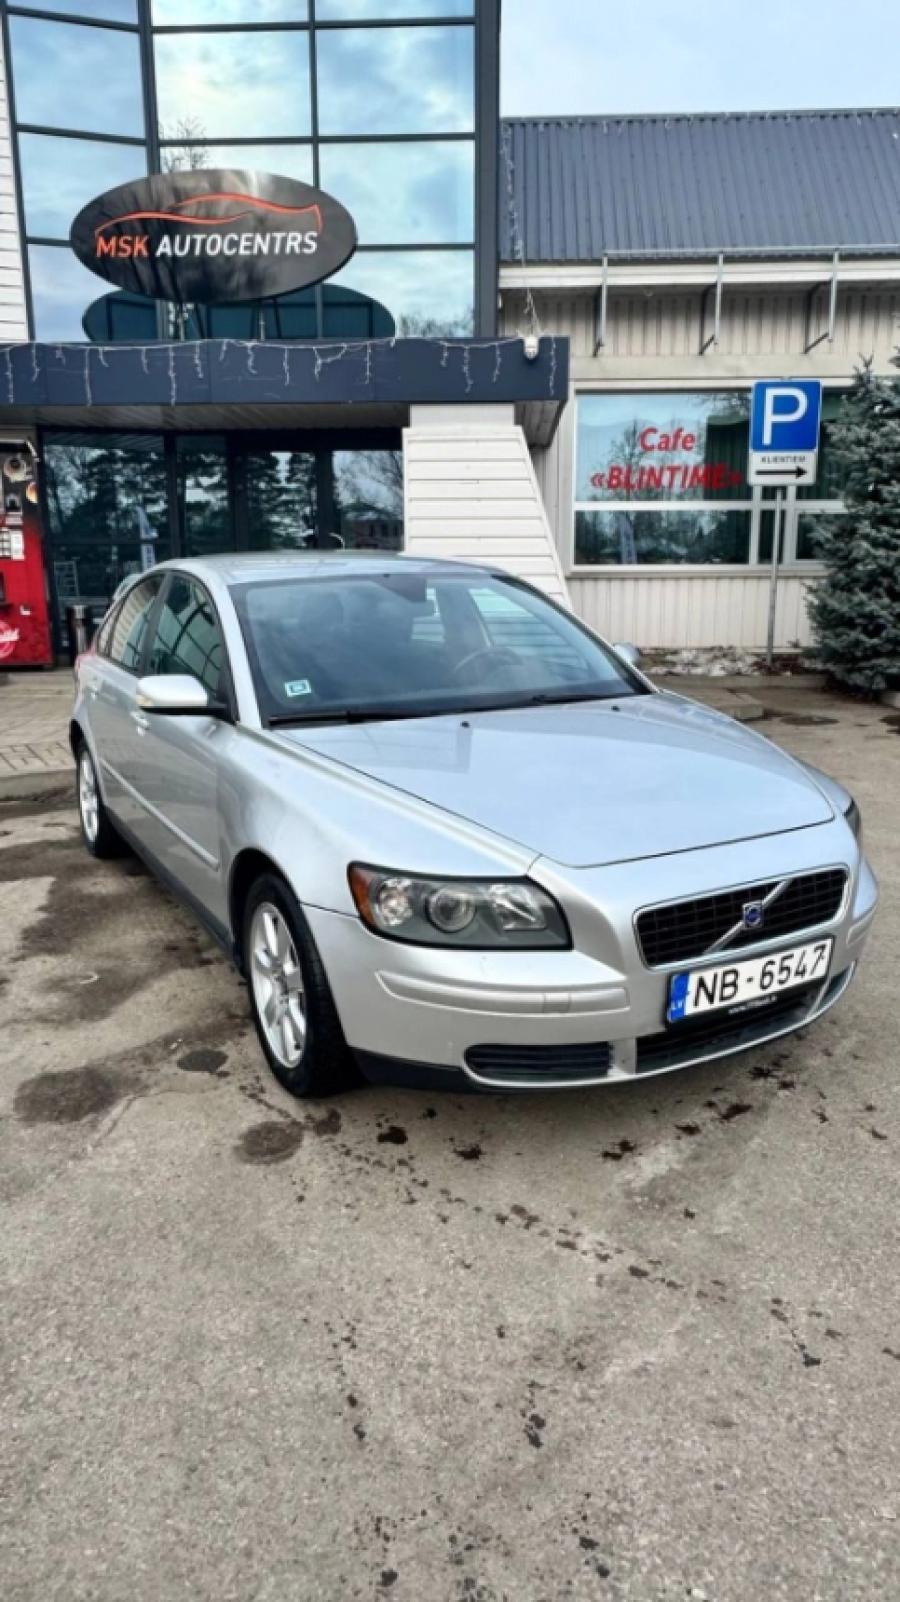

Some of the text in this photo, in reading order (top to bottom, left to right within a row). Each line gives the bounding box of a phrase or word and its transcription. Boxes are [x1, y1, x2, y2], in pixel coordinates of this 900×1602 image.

[96, 231, 318, 258] MSK AUTOCENTRS
[762, 387, 808, 446] P
[638, 426, 696, 452] Cafe
